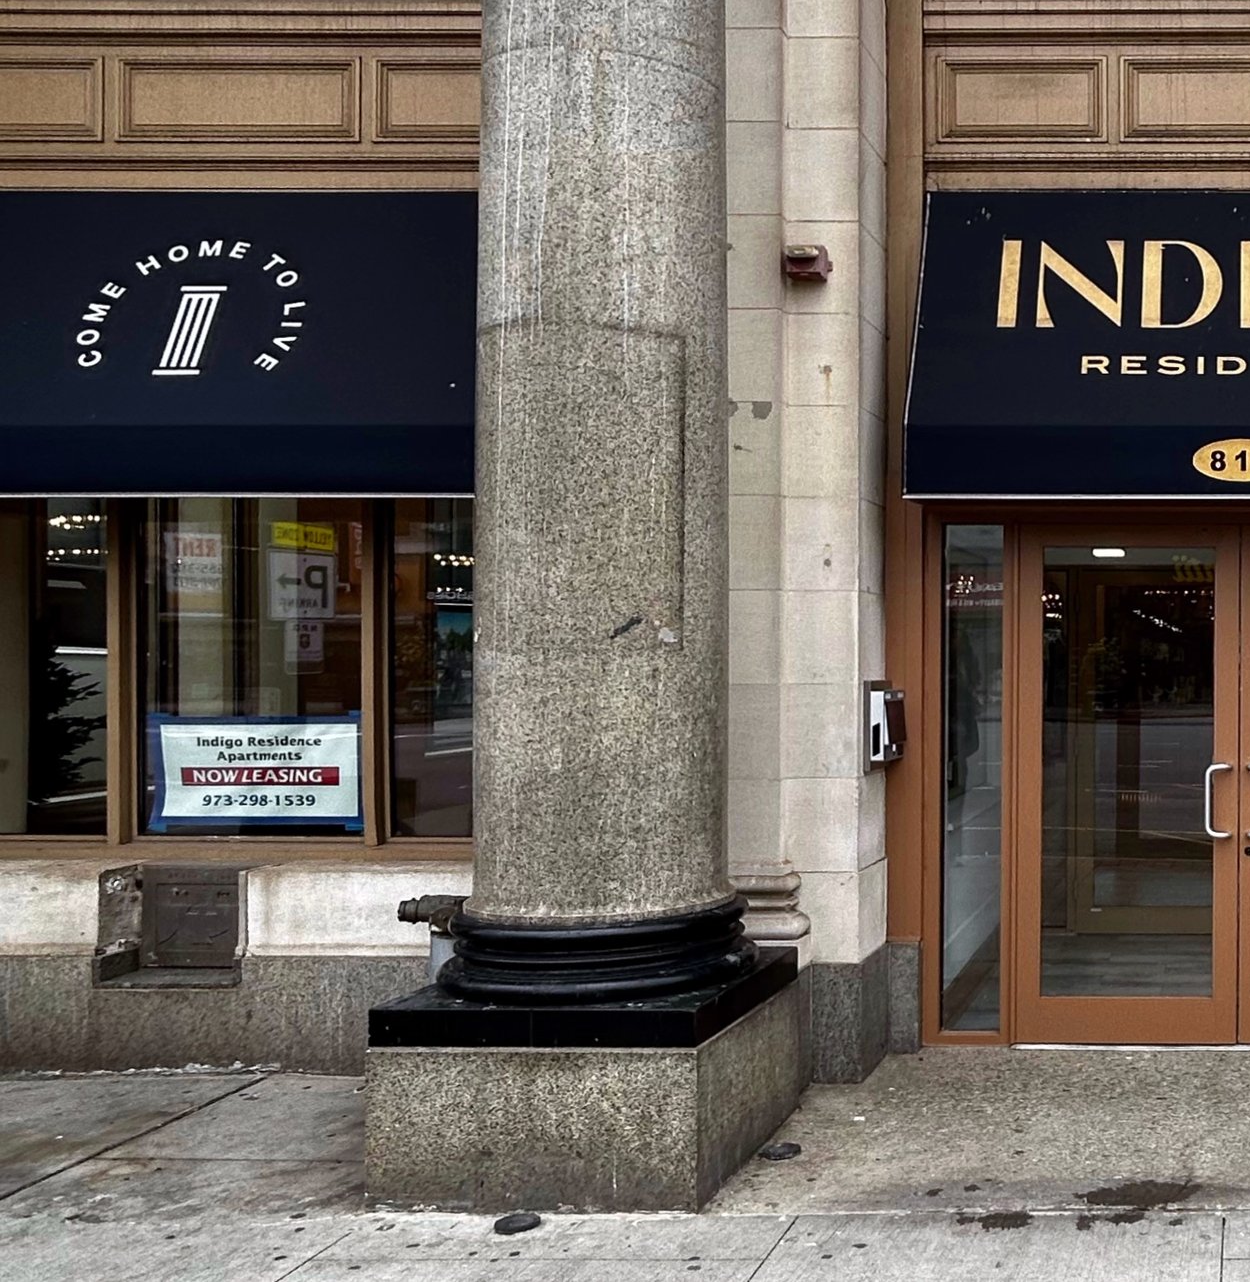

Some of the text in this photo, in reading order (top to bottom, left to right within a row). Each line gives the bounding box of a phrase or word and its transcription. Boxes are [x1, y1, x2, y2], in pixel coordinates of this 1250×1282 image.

[75, 240, 306, 371] COME HOME TO LIVE
[196, 736, 322, 749] Indigo Residence
[216, 751, 302, 763] Apartments
[192, 768, 323, 783] NOW LEASING
[201, 794, 316, 807] 973-298-1539
